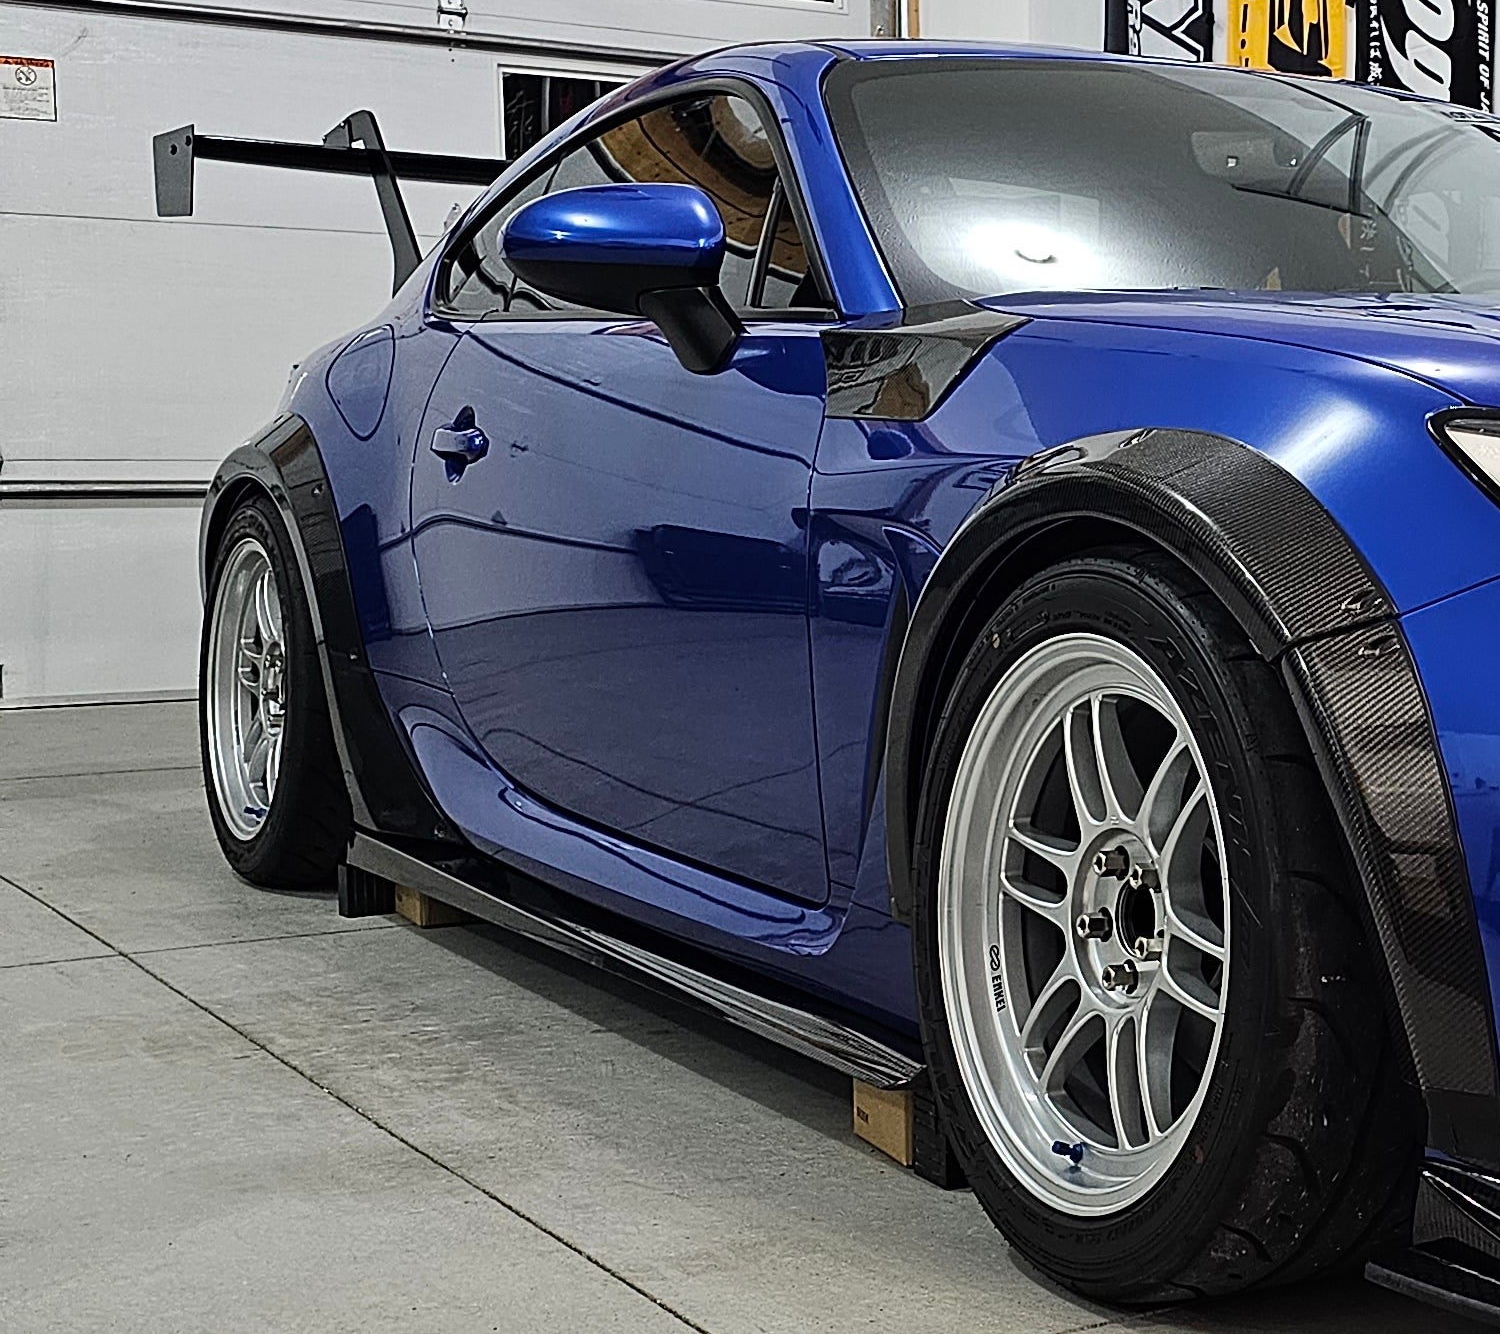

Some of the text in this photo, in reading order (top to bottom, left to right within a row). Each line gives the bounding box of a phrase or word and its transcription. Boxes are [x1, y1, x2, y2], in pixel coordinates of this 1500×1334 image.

[1475, 0, 1490, 62] SPIRIT
[1478, 63, 1491, 90] OF
[991, 973, 1007, 1013] ENKEI
